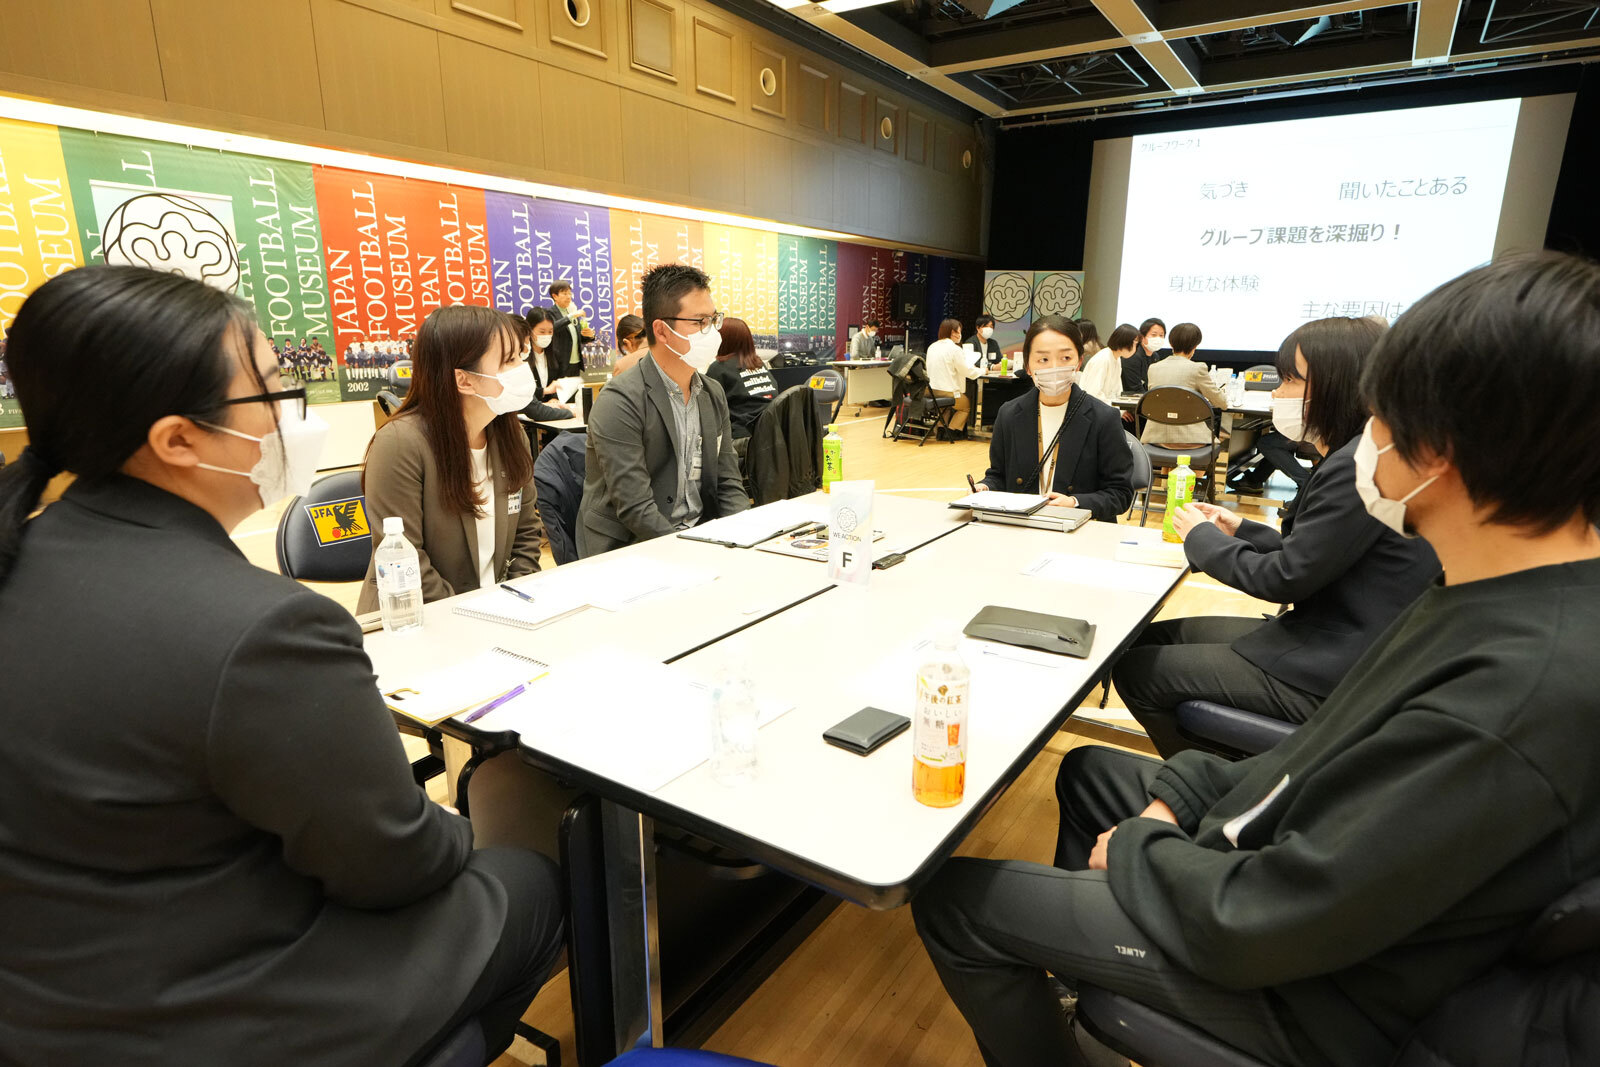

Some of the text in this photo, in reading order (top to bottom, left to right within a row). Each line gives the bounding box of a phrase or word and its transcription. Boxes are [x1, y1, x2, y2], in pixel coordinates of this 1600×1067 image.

[1200, 180, 1249, 201] 気づき
[1338, 175, 1468, 201] 聞いたことある
[24, 173, 77, 284] SEUM
[249, 167, 296, 338] FOOTBALL
[351, 181, 390, 338] FOOTBALL
[438, 192, 466, 307] OTBALL
[466, 222, 491, 308] USEUM
[512, 202, 535, 320] OOTBALL
[289, 203, 329, 337] MUSEUM
[327, 246, 365, 337] JAPAN
[384, 213, 417, 336] MUSEUM
[493, 258, 514, 315] PAN
[575, 210, 596, 332] OOTBALL
[594, 236, 613, 334] MUSEUM
[614, 267, 629, 320] APAN
[756, 236, 767, 331] FOOTBALL
[767, 256, 777, 331] MUSEUM
[779, 280, 789, 329] JAPAN
[789, 241, 799, 330] FOOTBALL
[799, 258, 808, 330] MUSEUM
[809, 281, 819, 329] JAPAN
[818, 244, 828, 330] FOOTBALL
[827, 262, 837, 330] MUSEUM
[870, 252, 879, 321] OOTBALL
[1168, 275, 1260, 293] 身近な体験
[347, 382, 370, 393] 2002
[314, 508, 334, 519] JFA
[833, 531, 862, 542] WE ACTION
[842, 551, 853, 568] F
